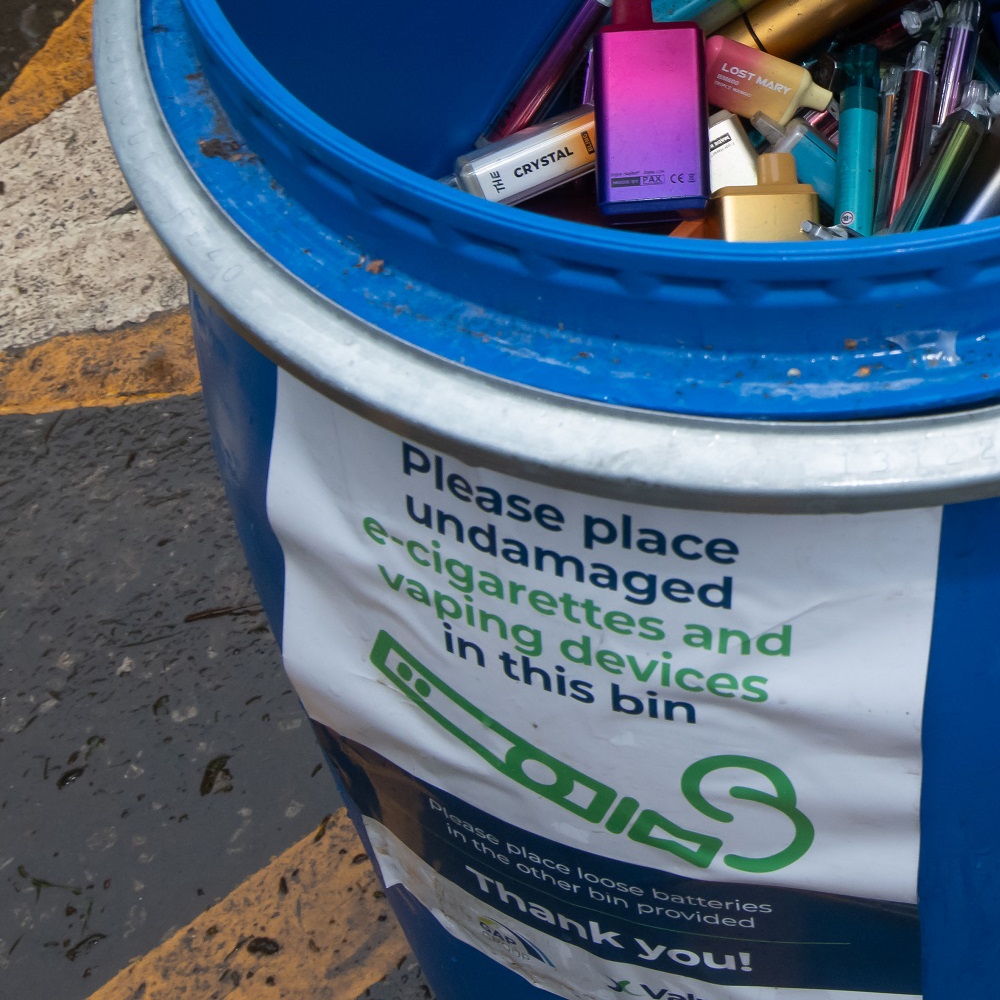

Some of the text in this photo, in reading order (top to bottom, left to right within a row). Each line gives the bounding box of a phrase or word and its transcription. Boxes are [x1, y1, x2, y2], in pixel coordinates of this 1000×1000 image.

[721, 62, 792, 95] LOST MARY
[489, 146, 574, 194] THE CRYSTAL
[642, 175, 661, 184] PAX
[402, 441, 740, 565] Please place
[405, 494, 734, 610] undamaged
[362, 516, 793, 658] e-cigarettes and
[377, 563, 770, 703] vaping devices
[442, 621, 697, 725] in this bin
[429, 797, 773, 914] Please place loose batteries
[446, 822, 756, 929] in the other bin provided
[464, 864, 753, 972] Thank you!
[479, 921, 517, 945] GAP
